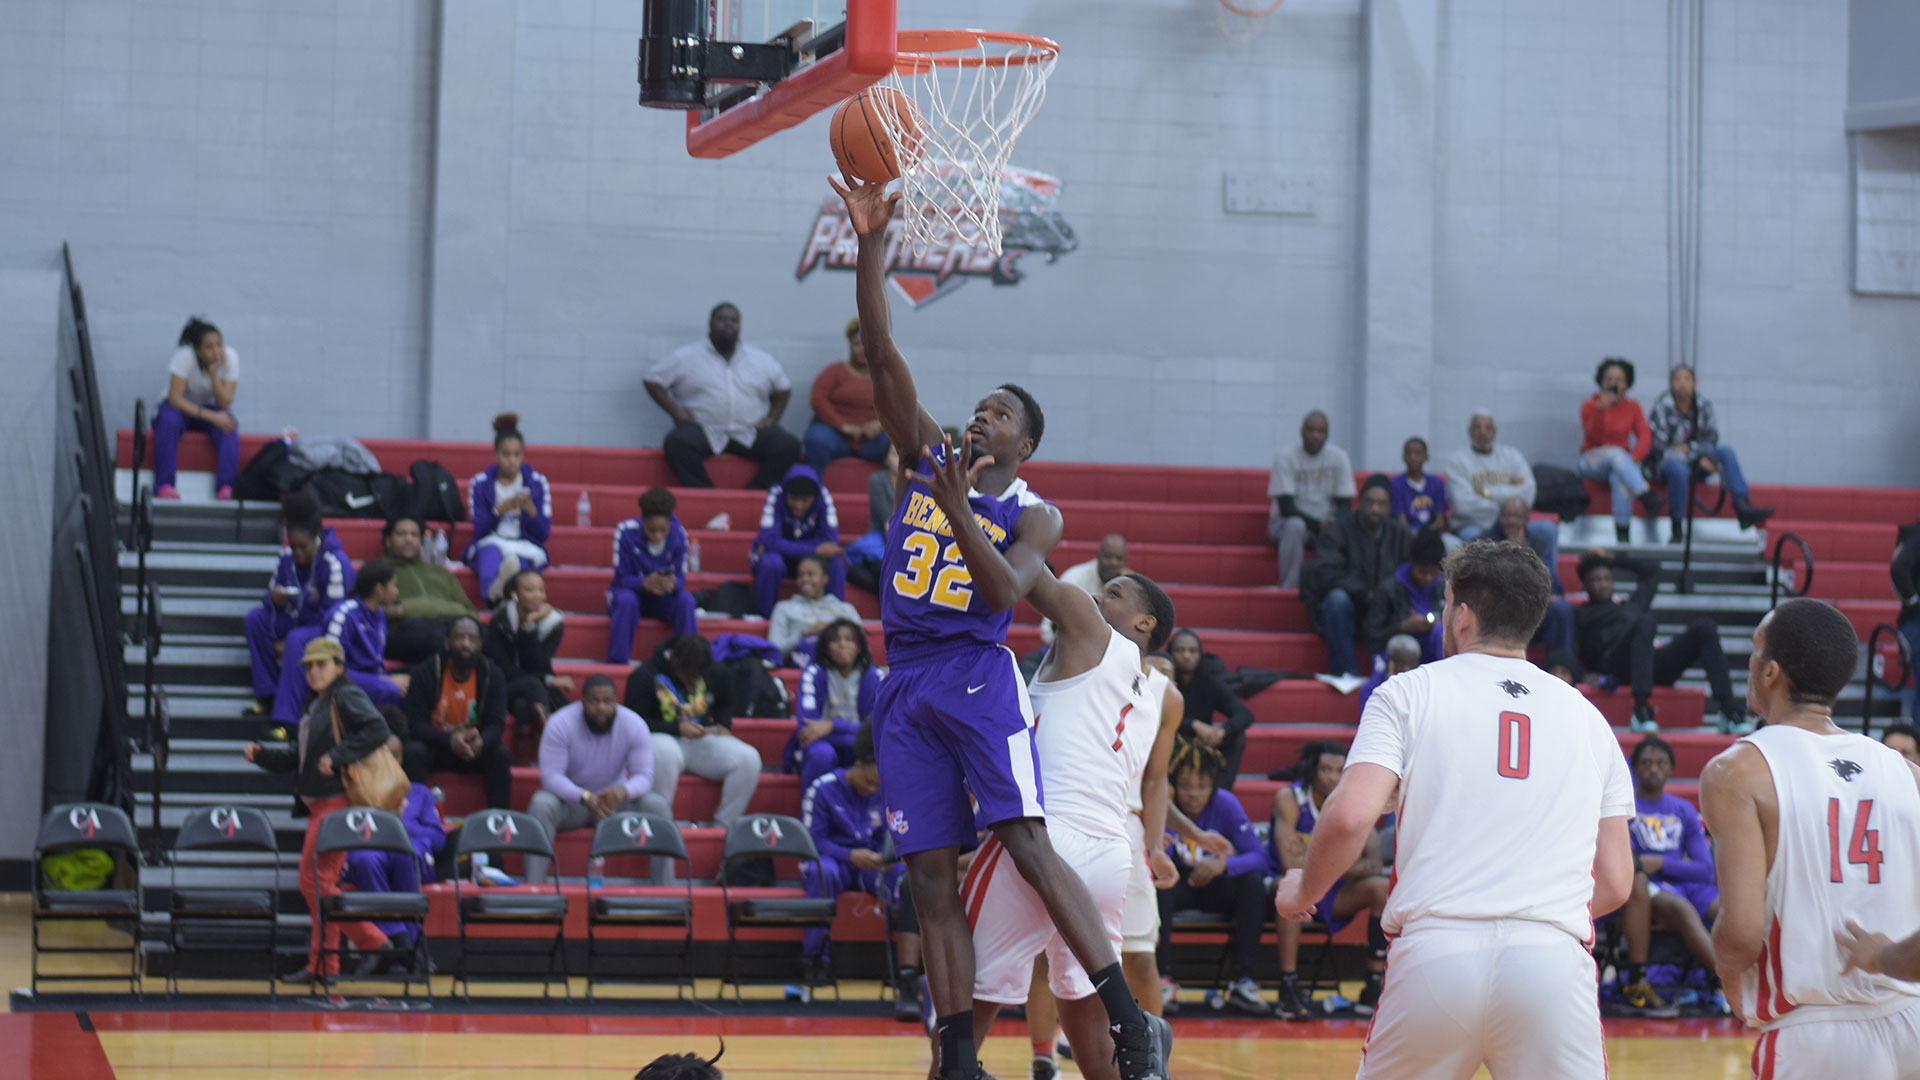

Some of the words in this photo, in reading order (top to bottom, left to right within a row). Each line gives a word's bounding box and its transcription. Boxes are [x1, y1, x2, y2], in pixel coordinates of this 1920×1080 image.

[797, 214, 1008, 278] PATHERS
[902, 490, 1007, 544] BENCT
[893, 530, 973, 612] 32
[1112, 702, 1134, 753] 1
[1497, 710, 1531, 780] 0
[1827, 797, 1884, 884] 14
